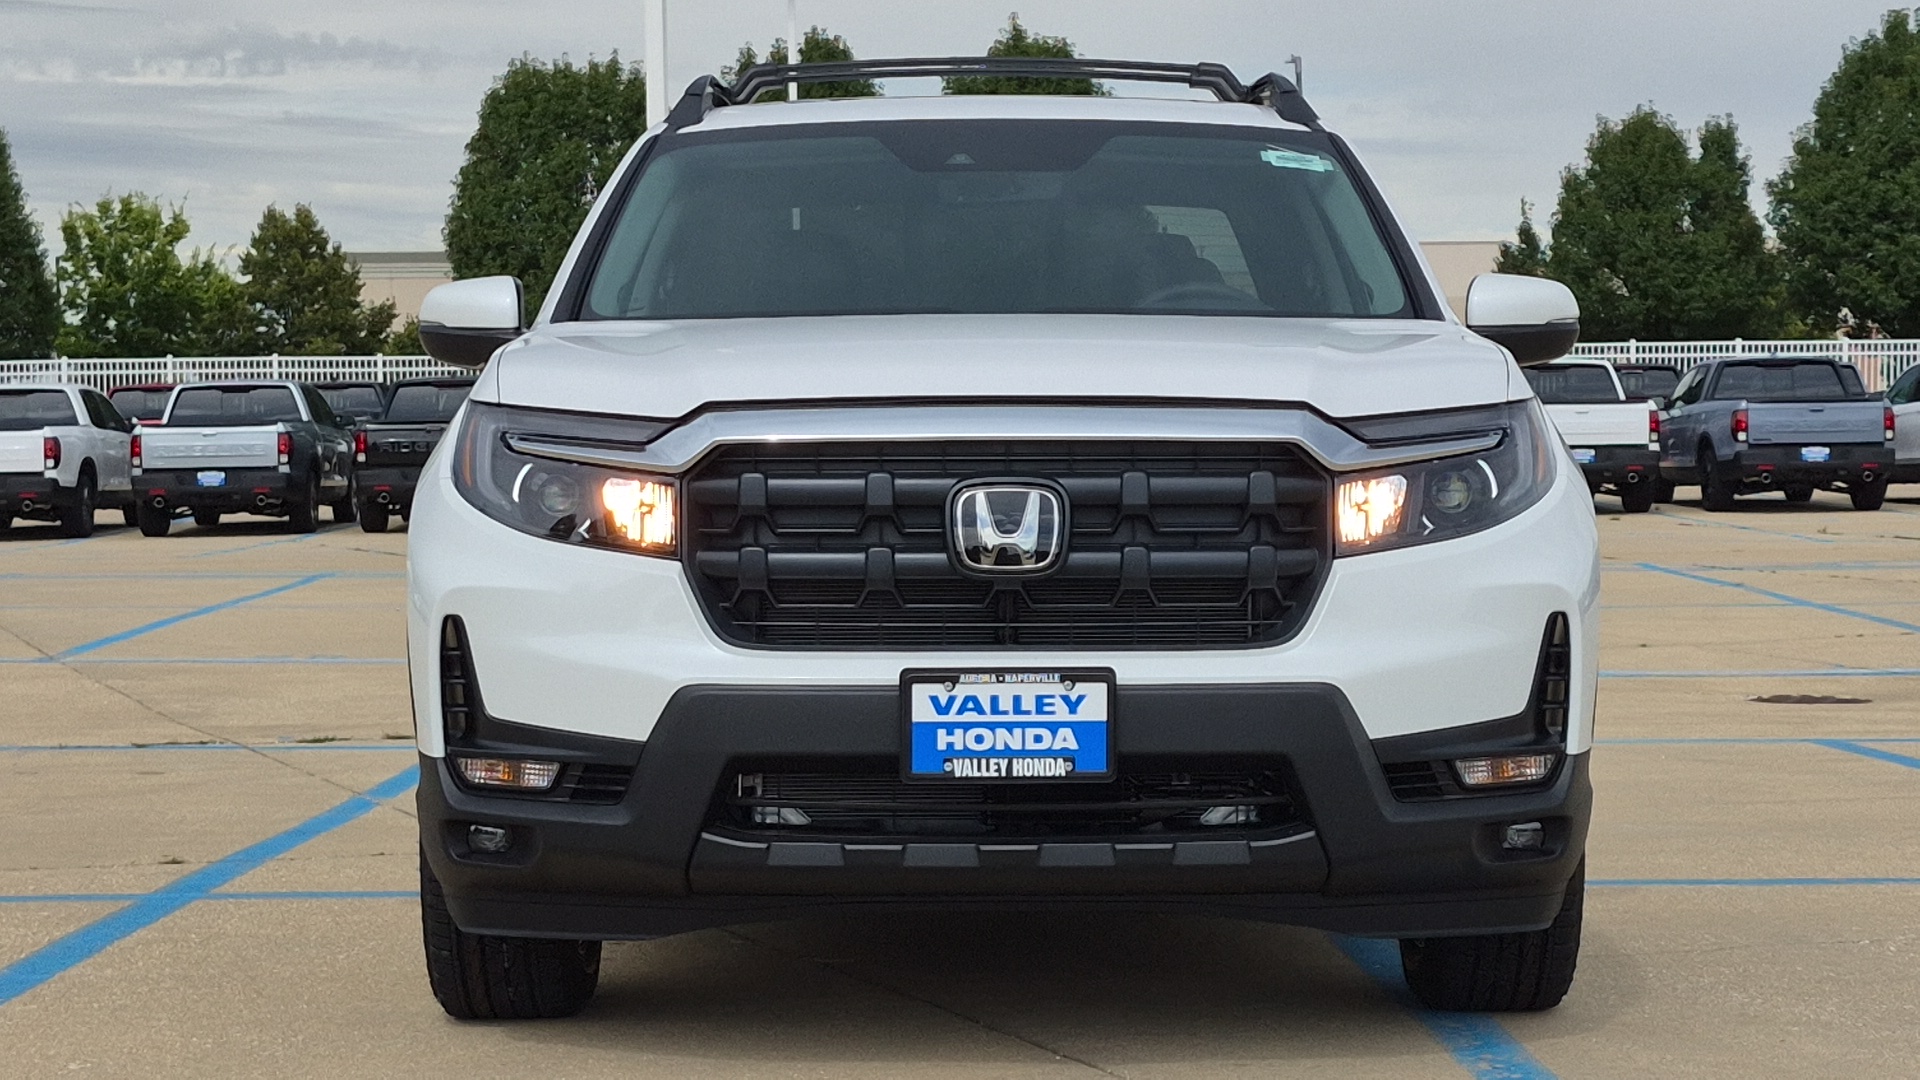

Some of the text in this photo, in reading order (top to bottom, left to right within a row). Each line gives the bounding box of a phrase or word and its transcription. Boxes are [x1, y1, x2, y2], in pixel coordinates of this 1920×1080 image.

[1004, 673, 1060, 683] NAPERVILLE
[929, 694, 1087, 715] VALLEY
[937, 728, 1080, 751] HONDA
[952, 758, 1067, 777] VALLEY HONDA
